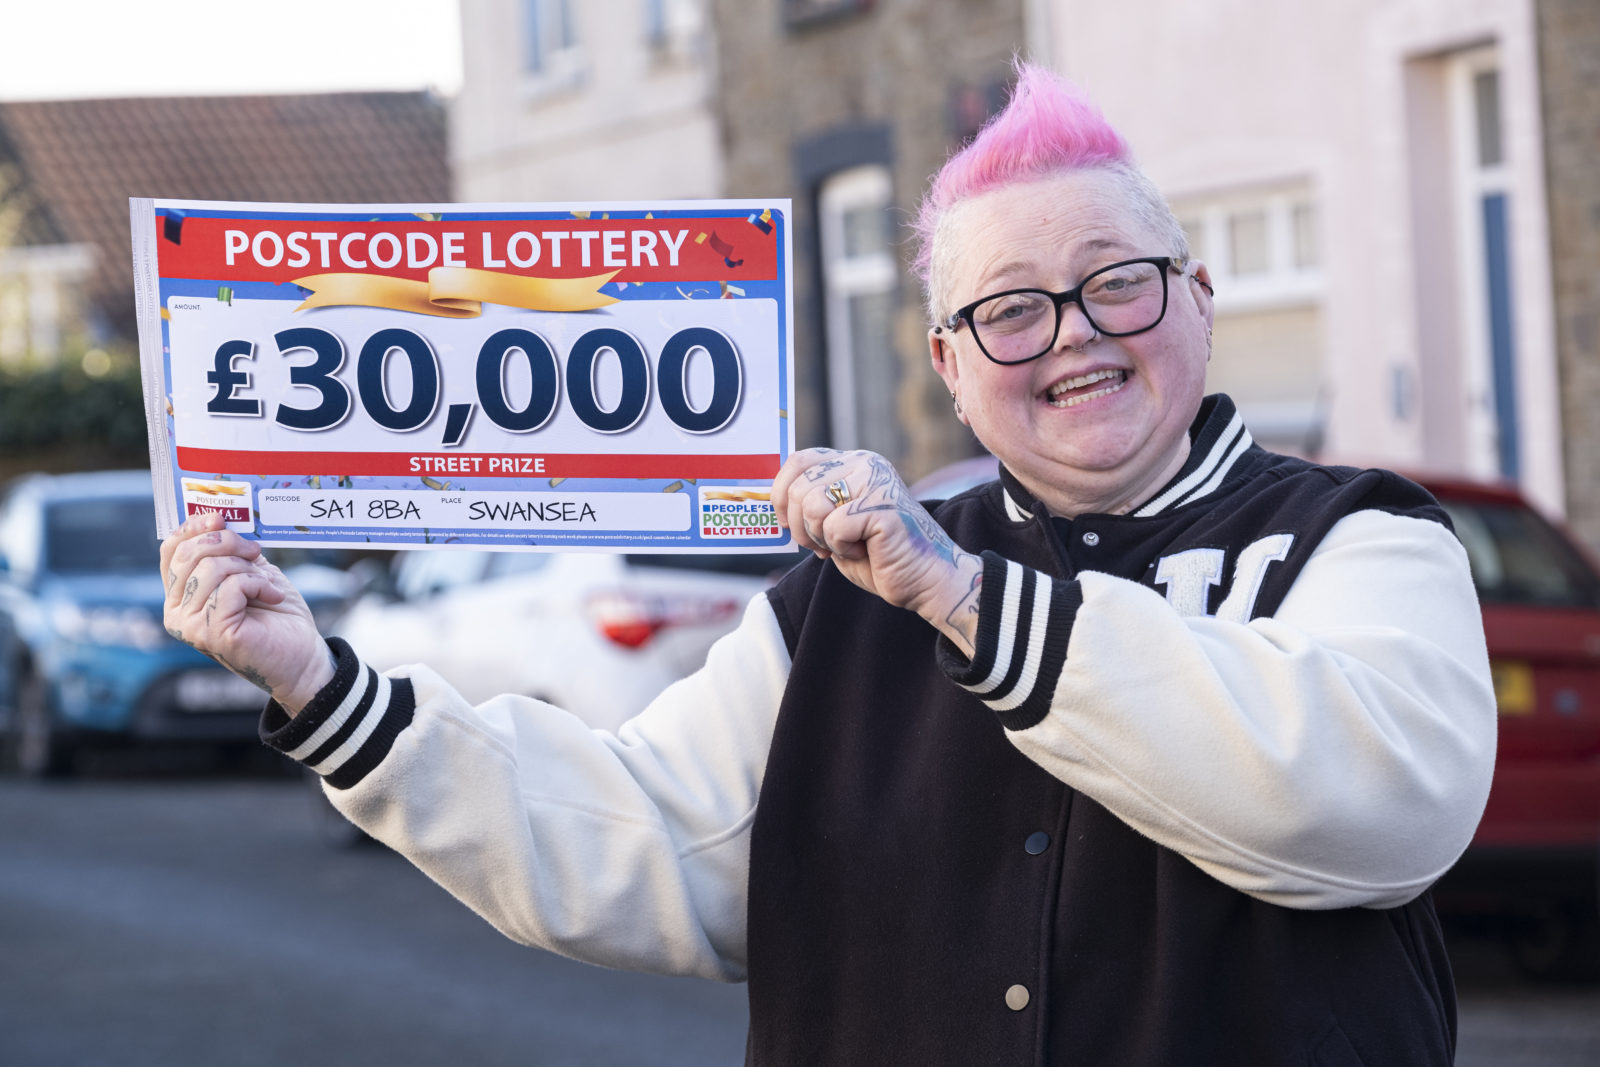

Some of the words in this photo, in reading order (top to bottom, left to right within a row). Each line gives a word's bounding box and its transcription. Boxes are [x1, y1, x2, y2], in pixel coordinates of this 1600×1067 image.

[225, 230, 468, 269] POSTCODE
[482, 229, 689, 268] LOTTERY
[207, 327, 743, 447] £30,000
[409, 457, 483, 472] STREET
[489, 458, 546, 473] PRIZE
[196, 496, 236, 506] POSTCODE
[712, 504, 768, 513] PEOPLE'S
[310, 499, 354, 519] SA1
[367, 500, 421, 520] 8BA
[468, 501, 597, 522] SWANSEA
[703, 513, 779, 527] POSTCODE
[713, 527, 769, 536] LOTTERY
